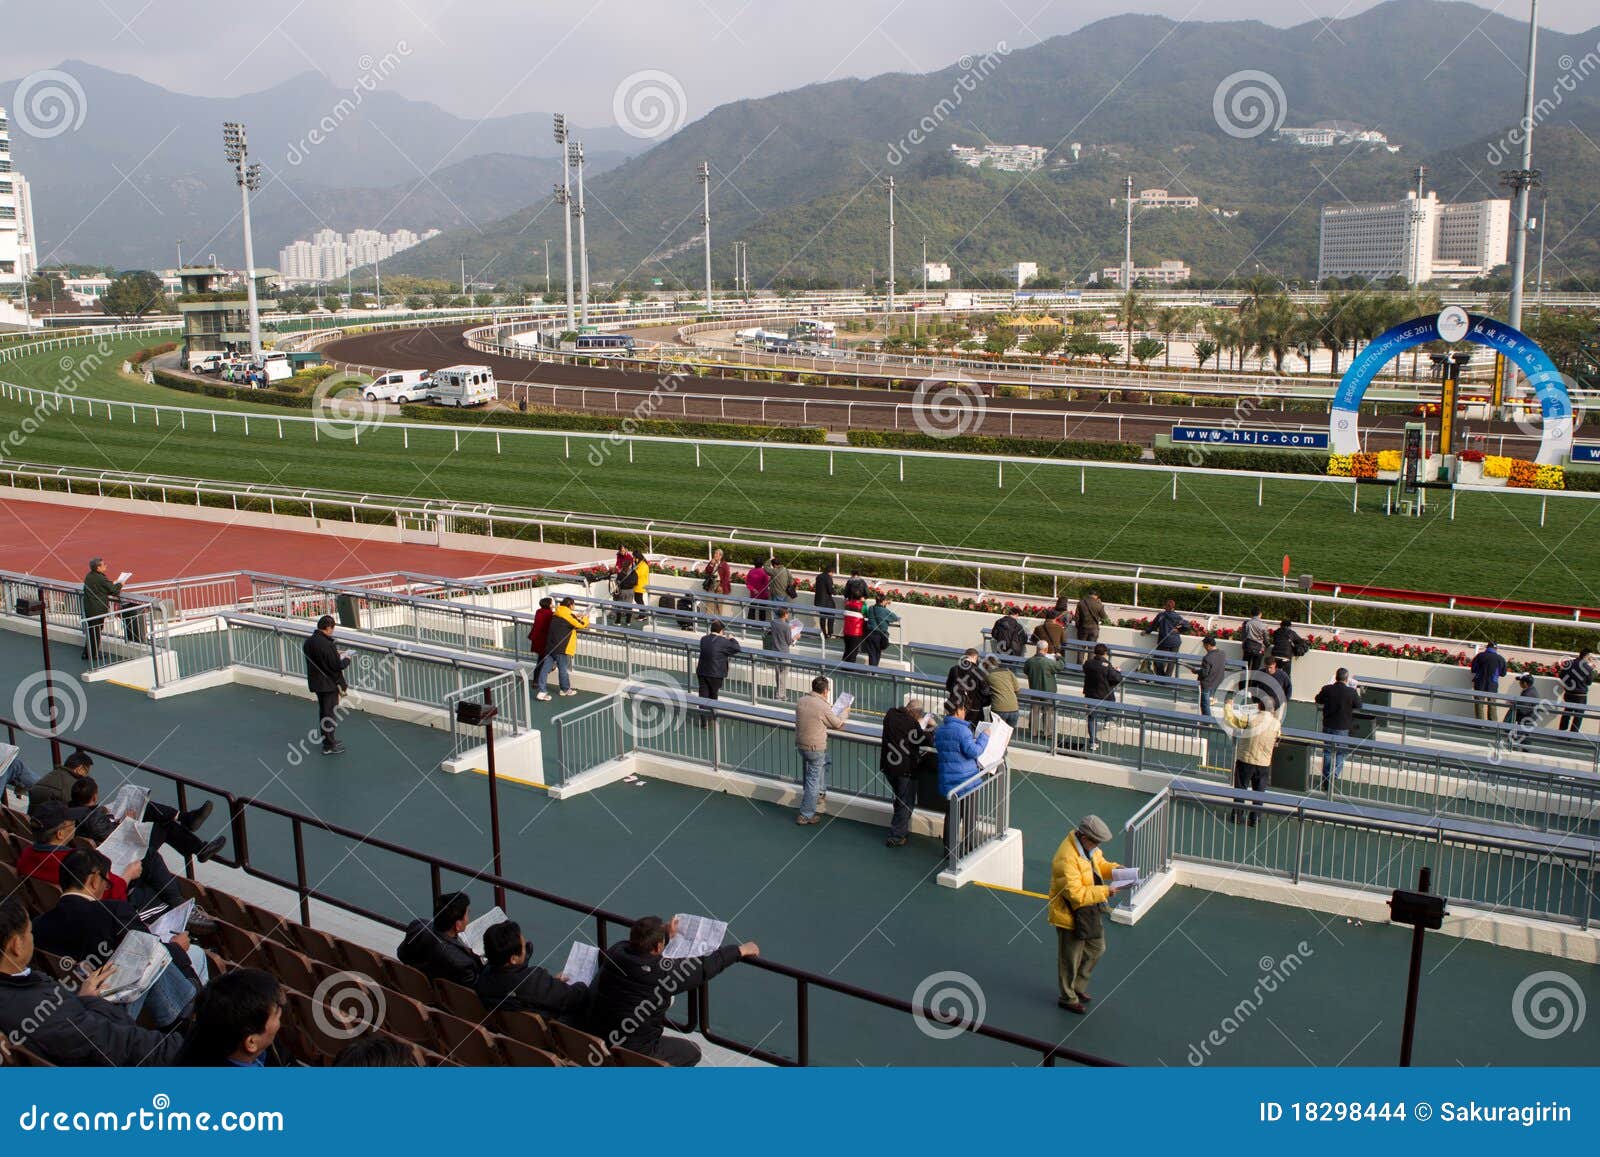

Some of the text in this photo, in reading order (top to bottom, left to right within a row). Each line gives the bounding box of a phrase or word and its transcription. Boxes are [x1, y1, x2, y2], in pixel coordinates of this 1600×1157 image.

[1356, 341, 1393, 378] CENTENARY
[1394, 329, 1414, 343] VASE
[1414, 324, 1433, 335] 2011
[1186, 430, 1315, 444] www.hkjc.com
